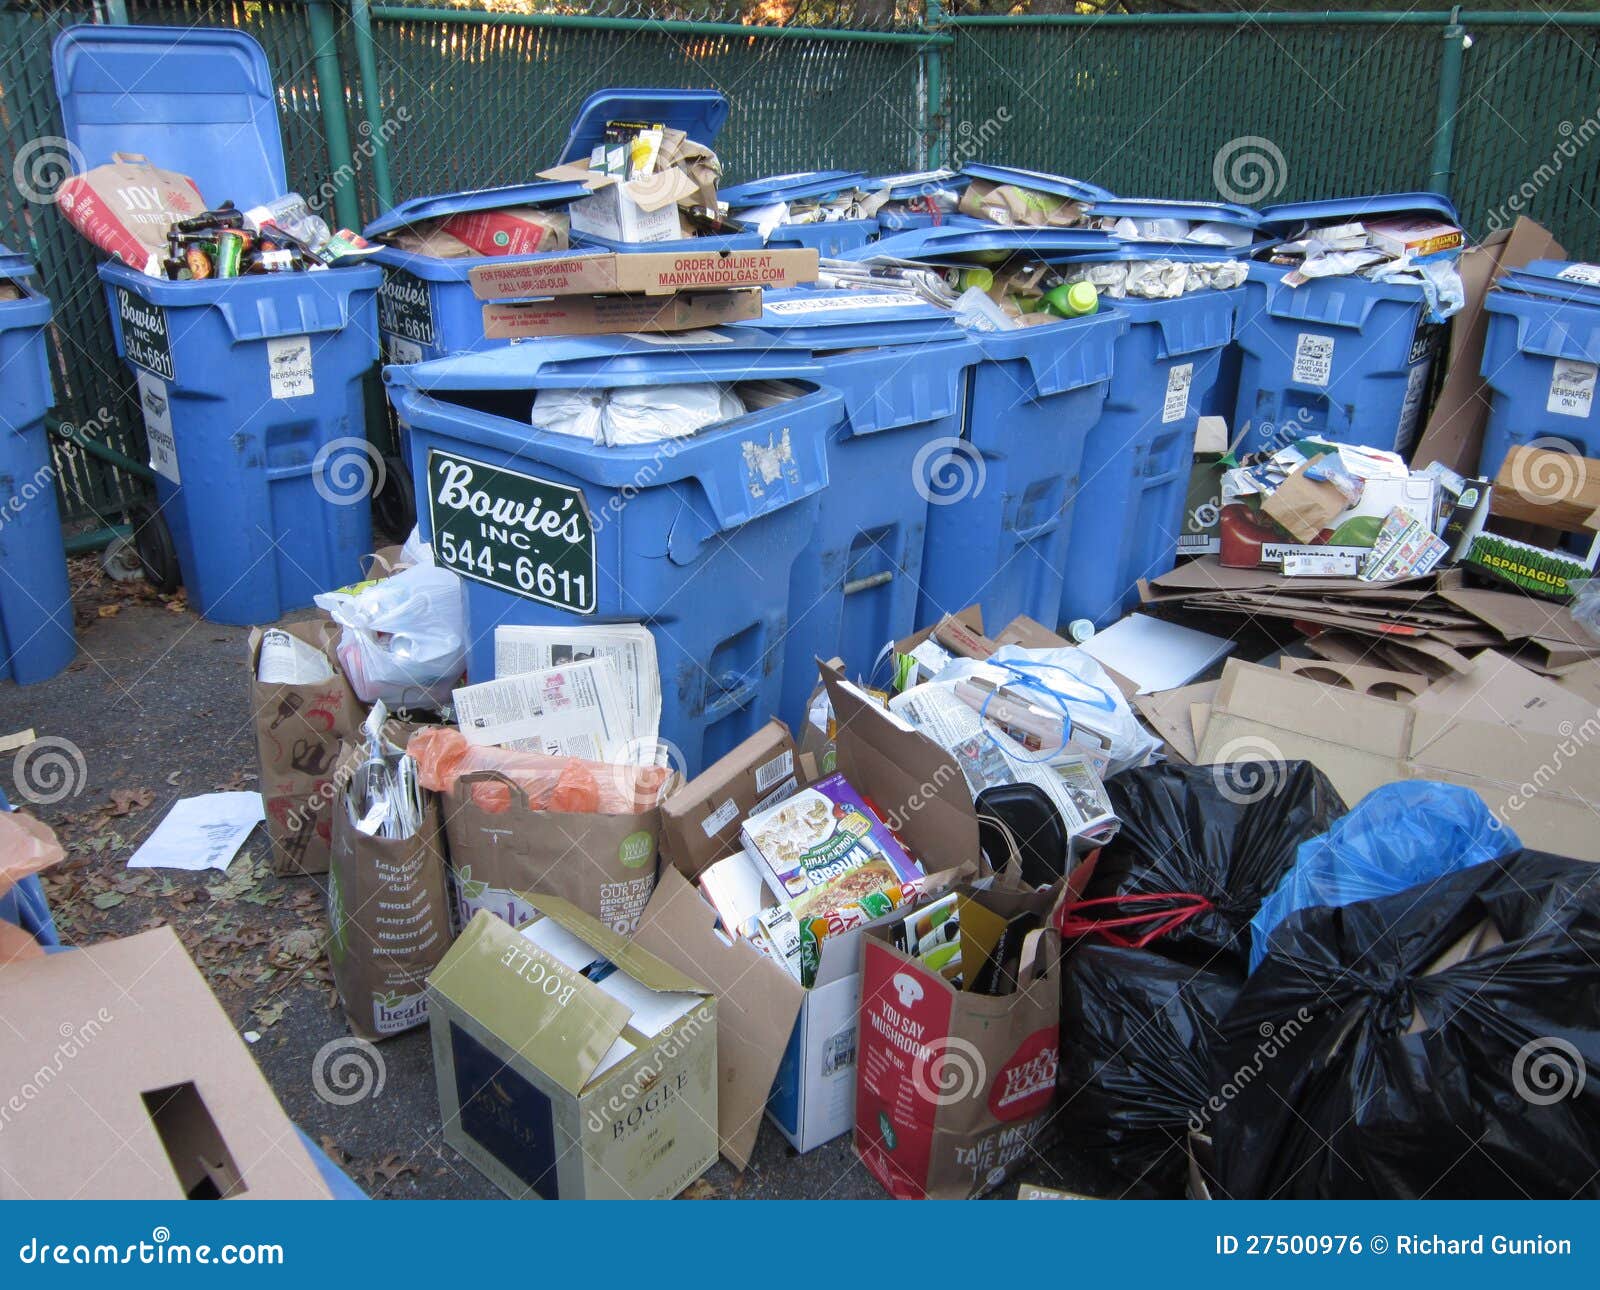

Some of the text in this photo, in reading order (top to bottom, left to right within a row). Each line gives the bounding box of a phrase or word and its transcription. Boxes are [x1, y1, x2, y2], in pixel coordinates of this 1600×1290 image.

[117, 185, 165, 210] JOY
[480, 270, 493, 281] FOR
[532, 262, 583, 275] INFORMATION
[659, 268, 785, 285] MANNYANDOLGAS.COM
[675, 256, 772, 271] ORDER ONLINE AT
[118, 289, 165, 335] Bowie's
[380, 310, 431, 342] 544-6611
[125, 336, 173, 376] 544-6611
[1551, 386, 1591, 401] NEWSPAPERS
[1561, 398, 1578, 408] ONLY
[437, 460, 586, 544] Bowie's
[480, 522, 540, 554] INC.
[441, 531, 586, 607] 544-6611
[1482, 553, 1567, 588] ASPARAGUS
[807, 845, 870, 886] Wheats
[600, 879, 655, 899] OUR PAP
[378, 901, 412, 910] WHOLE
[378, 930, 419, 940] HEALTHY
[500, 944, 577, 1009] BOGLE
[380, 998, 429, 1021] healt
[882, 1000, 925, 1039] YOU SAY
[1004, 1063, 1058, 1097] FOOD
[1005, 1047, 1059, 1083] WHOL
[612, 1070, 688, 1140] BOGLE
